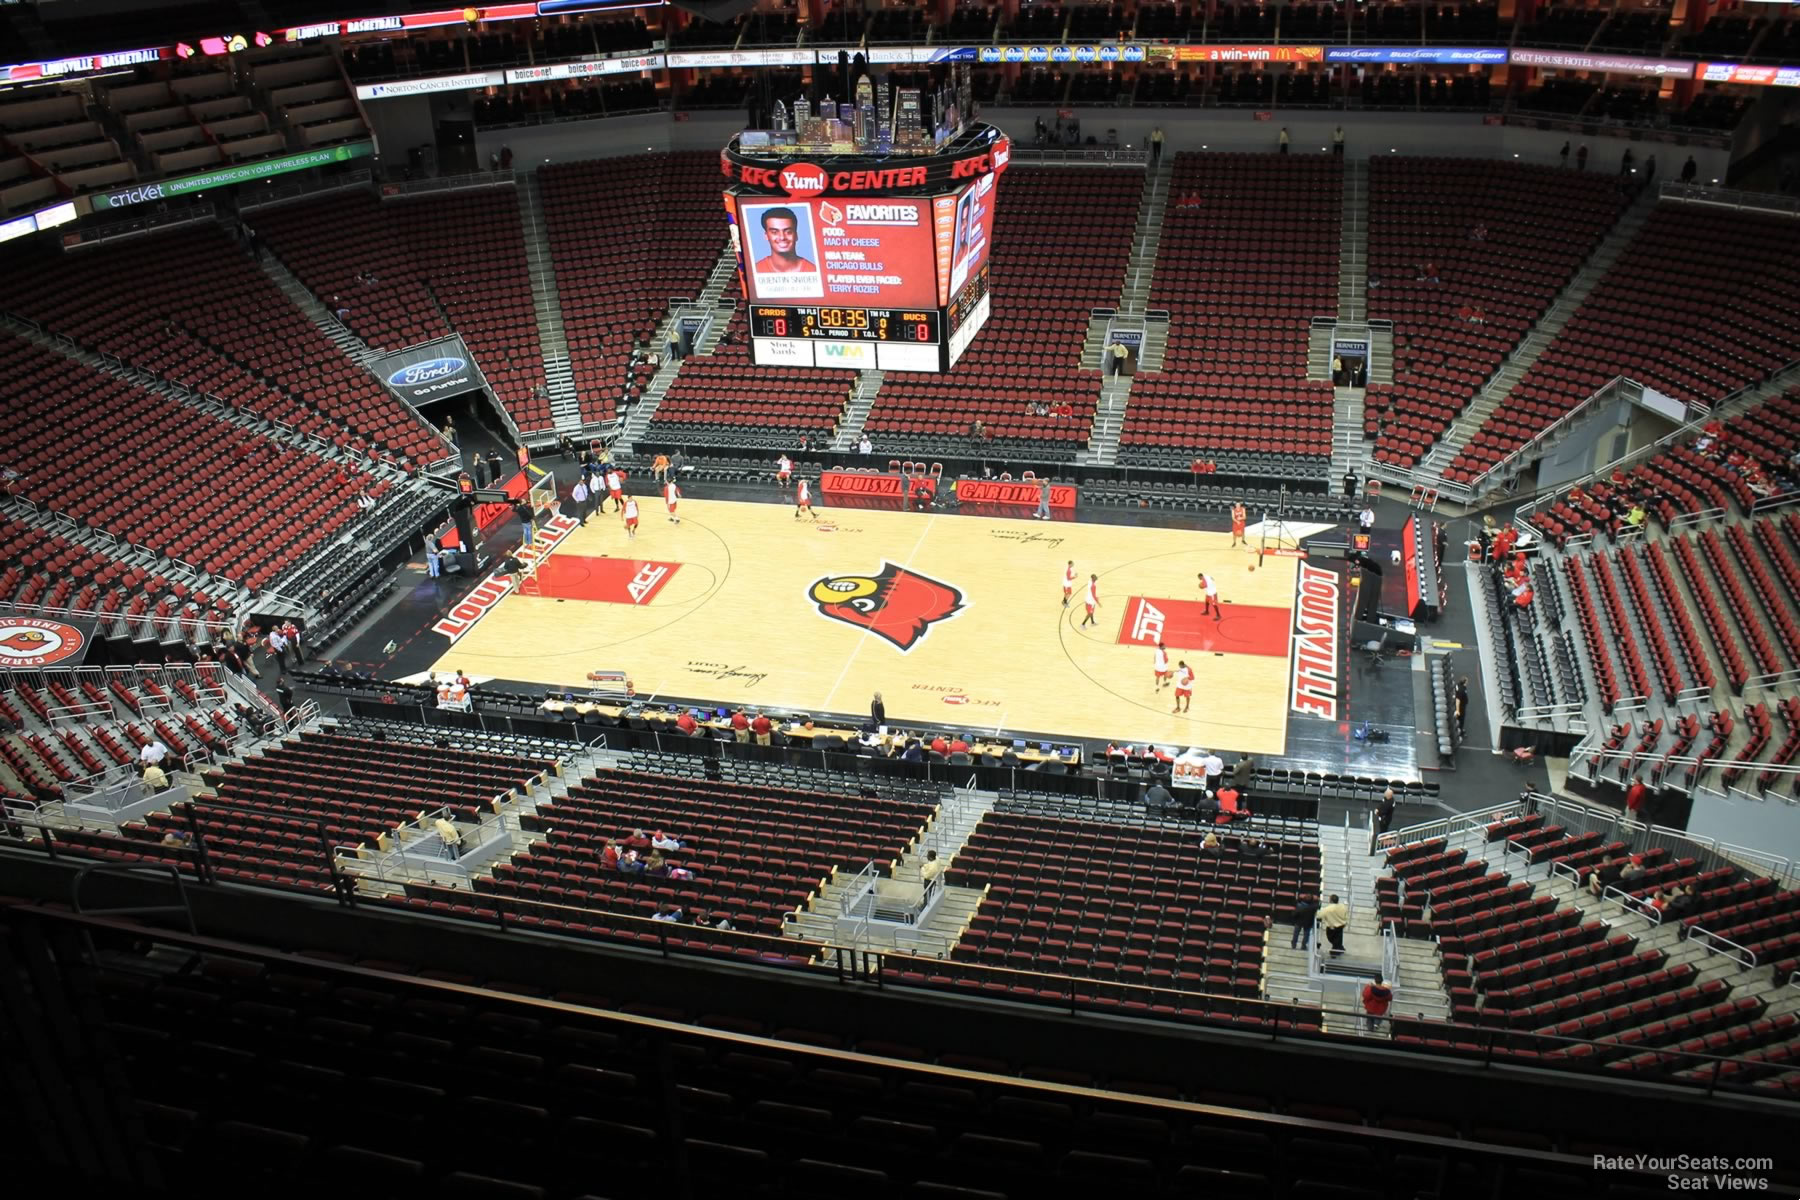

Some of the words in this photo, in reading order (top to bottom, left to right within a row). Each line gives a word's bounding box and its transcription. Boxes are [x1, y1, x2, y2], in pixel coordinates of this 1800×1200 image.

[297, 23, 340, 40] LOUISVILLE
[347, 17, 401, 33] BASKETBALL
[872, 52, 894, 60] Bank
[1211, 50, 1218, 60] a
[1221, 47, 1270, 60] win-win
[1511, 52, 1533, 63] GALT
[1534, 54, 1563, 65] HOUSE
[1564, 56, 1593, 67] HOTEL
[42, 57, 94, 76] LOUISVILLE
[101, 49, 160, 68] BASKETBALL
[386, 84, 418, 94] NORTON
[419, 80, 450, 91] CANCER
[451, 76, 489, 88] INSTITUTE
[170, 177, 212, 191] UNLIMITED
[212, 171, 237, 183] MUSIC
[238, 169, 251, 177] ON
[251, 164, 272, 175] YOUR
[273, 157, 310, 170] WIRELESS
[310, 152, 330, 164] PLAN
[952, 153, 989, 179] KFC
[740, 165, 777, 187] KFC
[783, 171, 824, 190] Yum!
[833, 166, 928, 191] CENTER
[846, 205, 918, 220] FAVORITES
[822, 227, 845, 236] FOOD:
[823, 238, 841, 246] MAC
[851, 238, 880, 247] CHEESE
[826, 261, 859, 270] CHICAGO
[860, 261, 883, 271] BULLS
[827, 274, 855, 283] PLAYER
[855, 275, 876, 284] EVER
[828, 284, 852, 293] TERRY
[853, 284, 880, 294] ROZIER
[759, 308, 786, 316] CARDS
[820, 309, 867, 327] 50:35
[903, 313, 927, 321] BUCS
[405, 361, 452, 383] Ford
[413, 387, 431, 396] Go
[430, 377, 469, 391] Further
[627, 562, 666, 601] ACC
[22, 619, 62, 631] FUND
[1136, 600, 1166, 645] ACC
[1291, 561, 1339, 721] LOUISVILLE
[911, 683, 963, 693] CENTER
